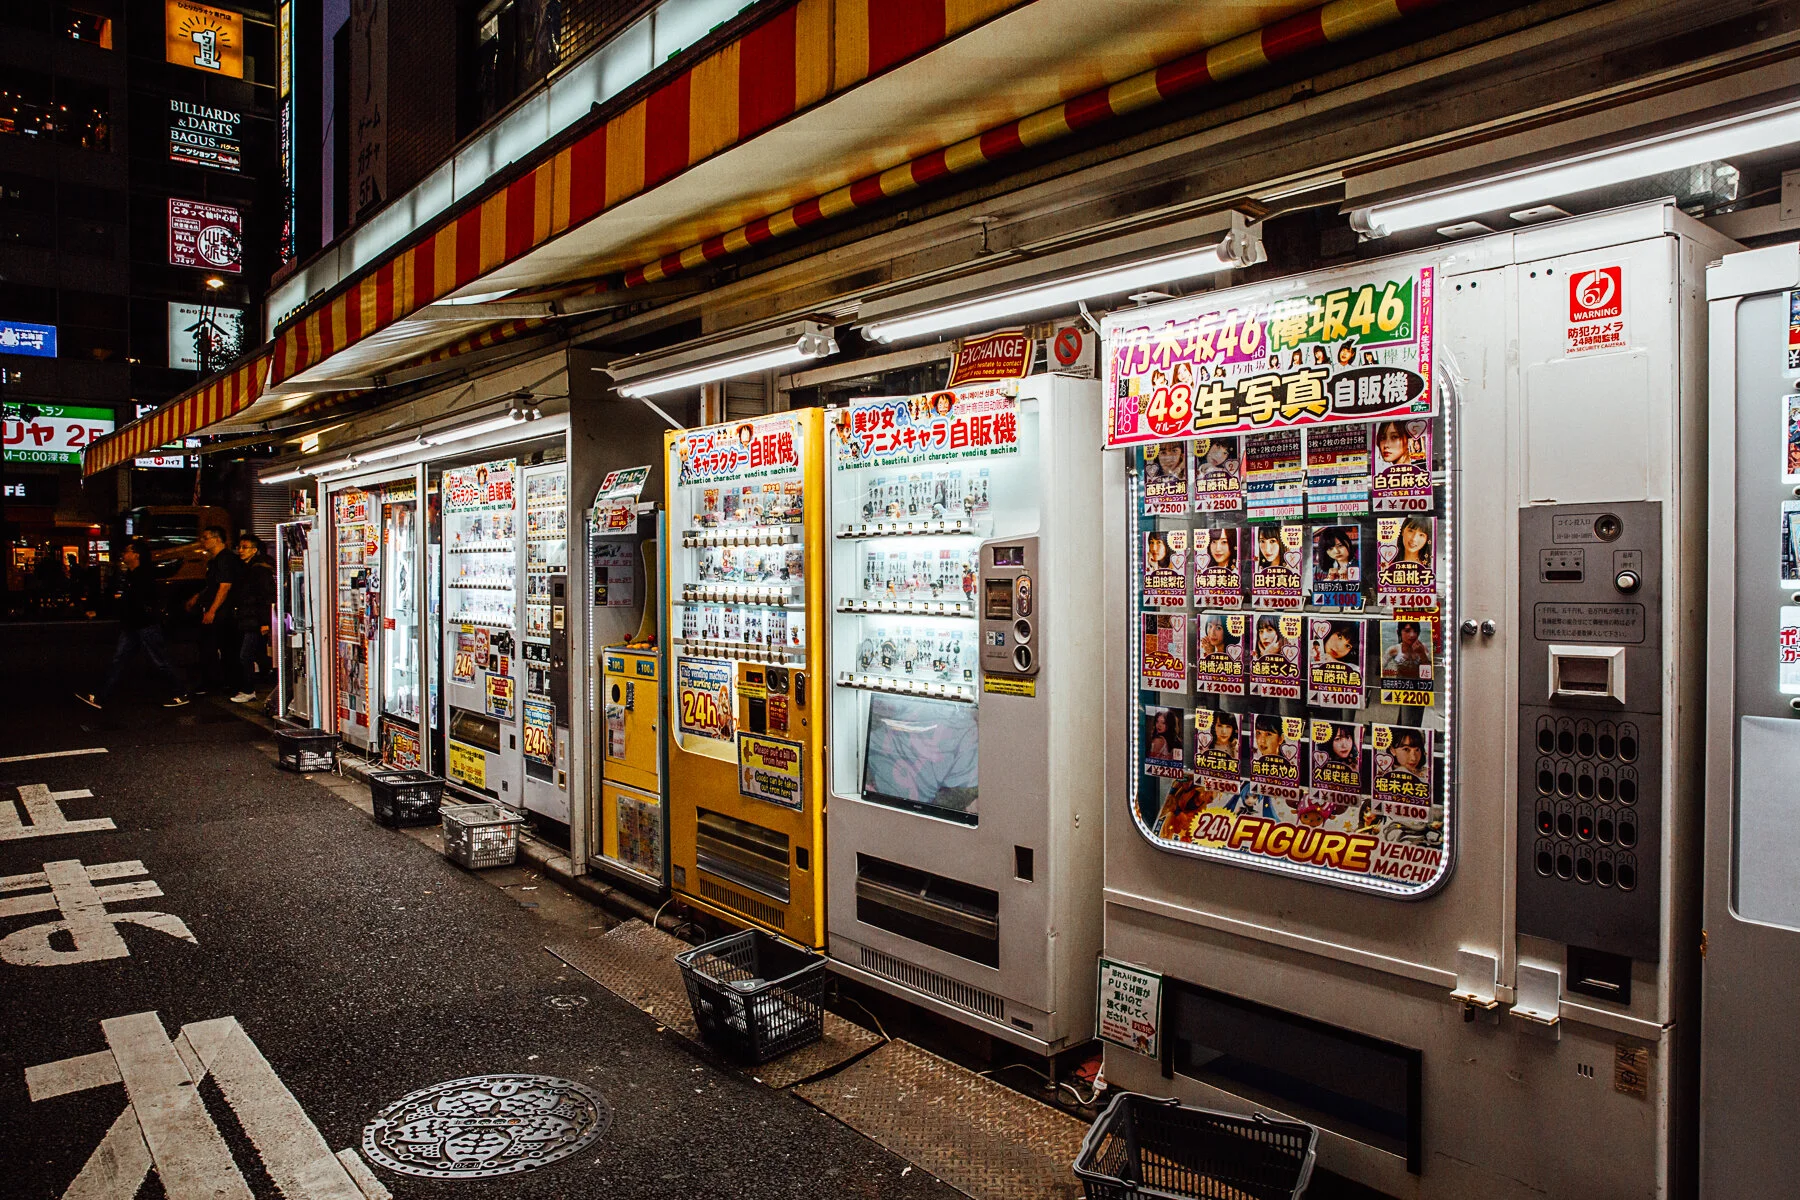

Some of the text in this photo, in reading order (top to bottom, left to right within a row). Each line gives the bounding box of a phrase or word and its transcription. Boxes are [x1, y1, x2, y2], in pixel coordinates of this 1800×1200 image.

[170, 99, 241, 124] BILLIARDS
[178, 116, 233, 136] & DARTS
[172, 145, 217, 159] ダーツショップ
[1573, 307, 1618, 321] WARNING
[1568, 321, 1624, 340] 防犯カメラ
[1122, 313, 1262, 376] 乃木坂46
[1572, 332, 1621, 347] 24時間監視
[1576, 344, 1600, 352] SECURITY
[1601, 341, 1626, 349] CAMERAS
[960, 339, 1024, 367] EXCHANGE
[1149, 387, 1190, 422] 48
[1195, 370, 1408, 429] 生写真 自販機
[854, 407, 908, 433] 美少女 &
[1155, 420, 1185, 433] グループ
[861, 412, 1017, 454] アニメキャラ 自販機
[688, 435, 714, 456] アニメ
[750, 431, 793, 468] 自販機
[693, 449, 748, 475] キャラクター
[845, 462, 871, 470] Animation
[882, 455, 910, 466] Beautiful
[912, 453, 926, 463] girl
[929, 452, 958, 461] character
[962, 448, 987, 458] vending
[990, 445, 1018, 454] machine
[713, 473, 741, 482] character
[744, 470, 768, 479] vending
[770, 466, 797, 476] machine
[1374, 472, 1430, 489] 白石麻衣
[4, 483, 26, 496] FÉ
[488, 481, 512, 502] 自販機
[1146, 482, 1187, 497] 西野七瀬
[1206, 500, 1237, 510] ¥2500
[1316, 505, 1328, 513] 1回
[1388, 499, 1428, 509] ¥700
[1558, 518, 1591, 527] コイン投入口
[1145, 575, 1186, 588] 生田絵梨花
[1196, 574, 1240, 589] 梅澤美波
[1254, 573, 1301, 589] 田村真佑
[1379, 569, 1434, 585] 大園桃子
[1154, 596, 1185, 607] ¥1500
[1205, 596, 1237, 607] ¥1300
[1264, 596, 1297, 608] ¥2000
[1390, 594, 1432, 608] ¥1400
[455, 653, 472, 677] 24h
[1145, 657, 1184, 671] ランダム
[1199, 661, 1242, 676] 掛橋沙耶香
[1252, 662, 1299, 677] 遠藤さくら
[691, 667, 708, 680] vending
[693, 679, 711, 690] working
[1147, 679, 1180, 690] ¥1000
[1206, 683, 1242, 694] ¥2000
[1262, 686, 1296, 698] ¥2000
[1323, 691, 1359, 706] ¥1000
[1394, 691, 1430, 706] ¥2200
[683, 691, 718, 730] 24h
[1543, 718, 1550, 730] 1
[1562, 721, 1570, 731] 2
[1582, 722, 1590, 733] 3
[1602, 723, 1612, 735] 4
[1623, 725, 1632, 737] 5
[525, 727, 546, 755] 24h
[755, 742, 769, 755] Please
[1196, 755, 1239, 774] 秋元真夏
[1252, 761, 1298, 780] 筒井あやめ
[1542, 759, 1550, 771] 6
[1561, 761, 1570, 773] 7
[1581, 763, 1590, 775] 8
[1602, 765, 1611, 777] 9
[1153, 765, 1184, 780] ¥2300
[1314, 768, 1360, 786] 久保史緒里
[1620, 767, 1635, 780] 10
[769, 786, 780, 795] from
[1205, 781, 1238, 793] ¥1500
[1261, 784, 1297, 800] ¥2000
[1375, 778, 1430, 798] 堀未央奈
[1321, 791, 1359, 806] ¥1000
[1385, 803, 1428, 820] ¥1100
[1540, 800, 1551, 812] 11
[1559, 802, 1573, 814] 12
[1578, 805, 1593, 818] 13
[1600, 807, 1614, 820] 14
[1619, 810, 1634, 823] 15
[1195, 814, 1376, 871] 24h FIGURE
[1538, 840, 1552, 852] 16
[1558, 843, 1572, 856] 17
[1578, 845, 1593, 859] 18
[1599, 848, 1613, 862] 19
[1618, 852, 1634, 865] 20
[1114, 990, 1143, 1008] 重いので
[1106, 998, 1149, 1021] 強く押してく
